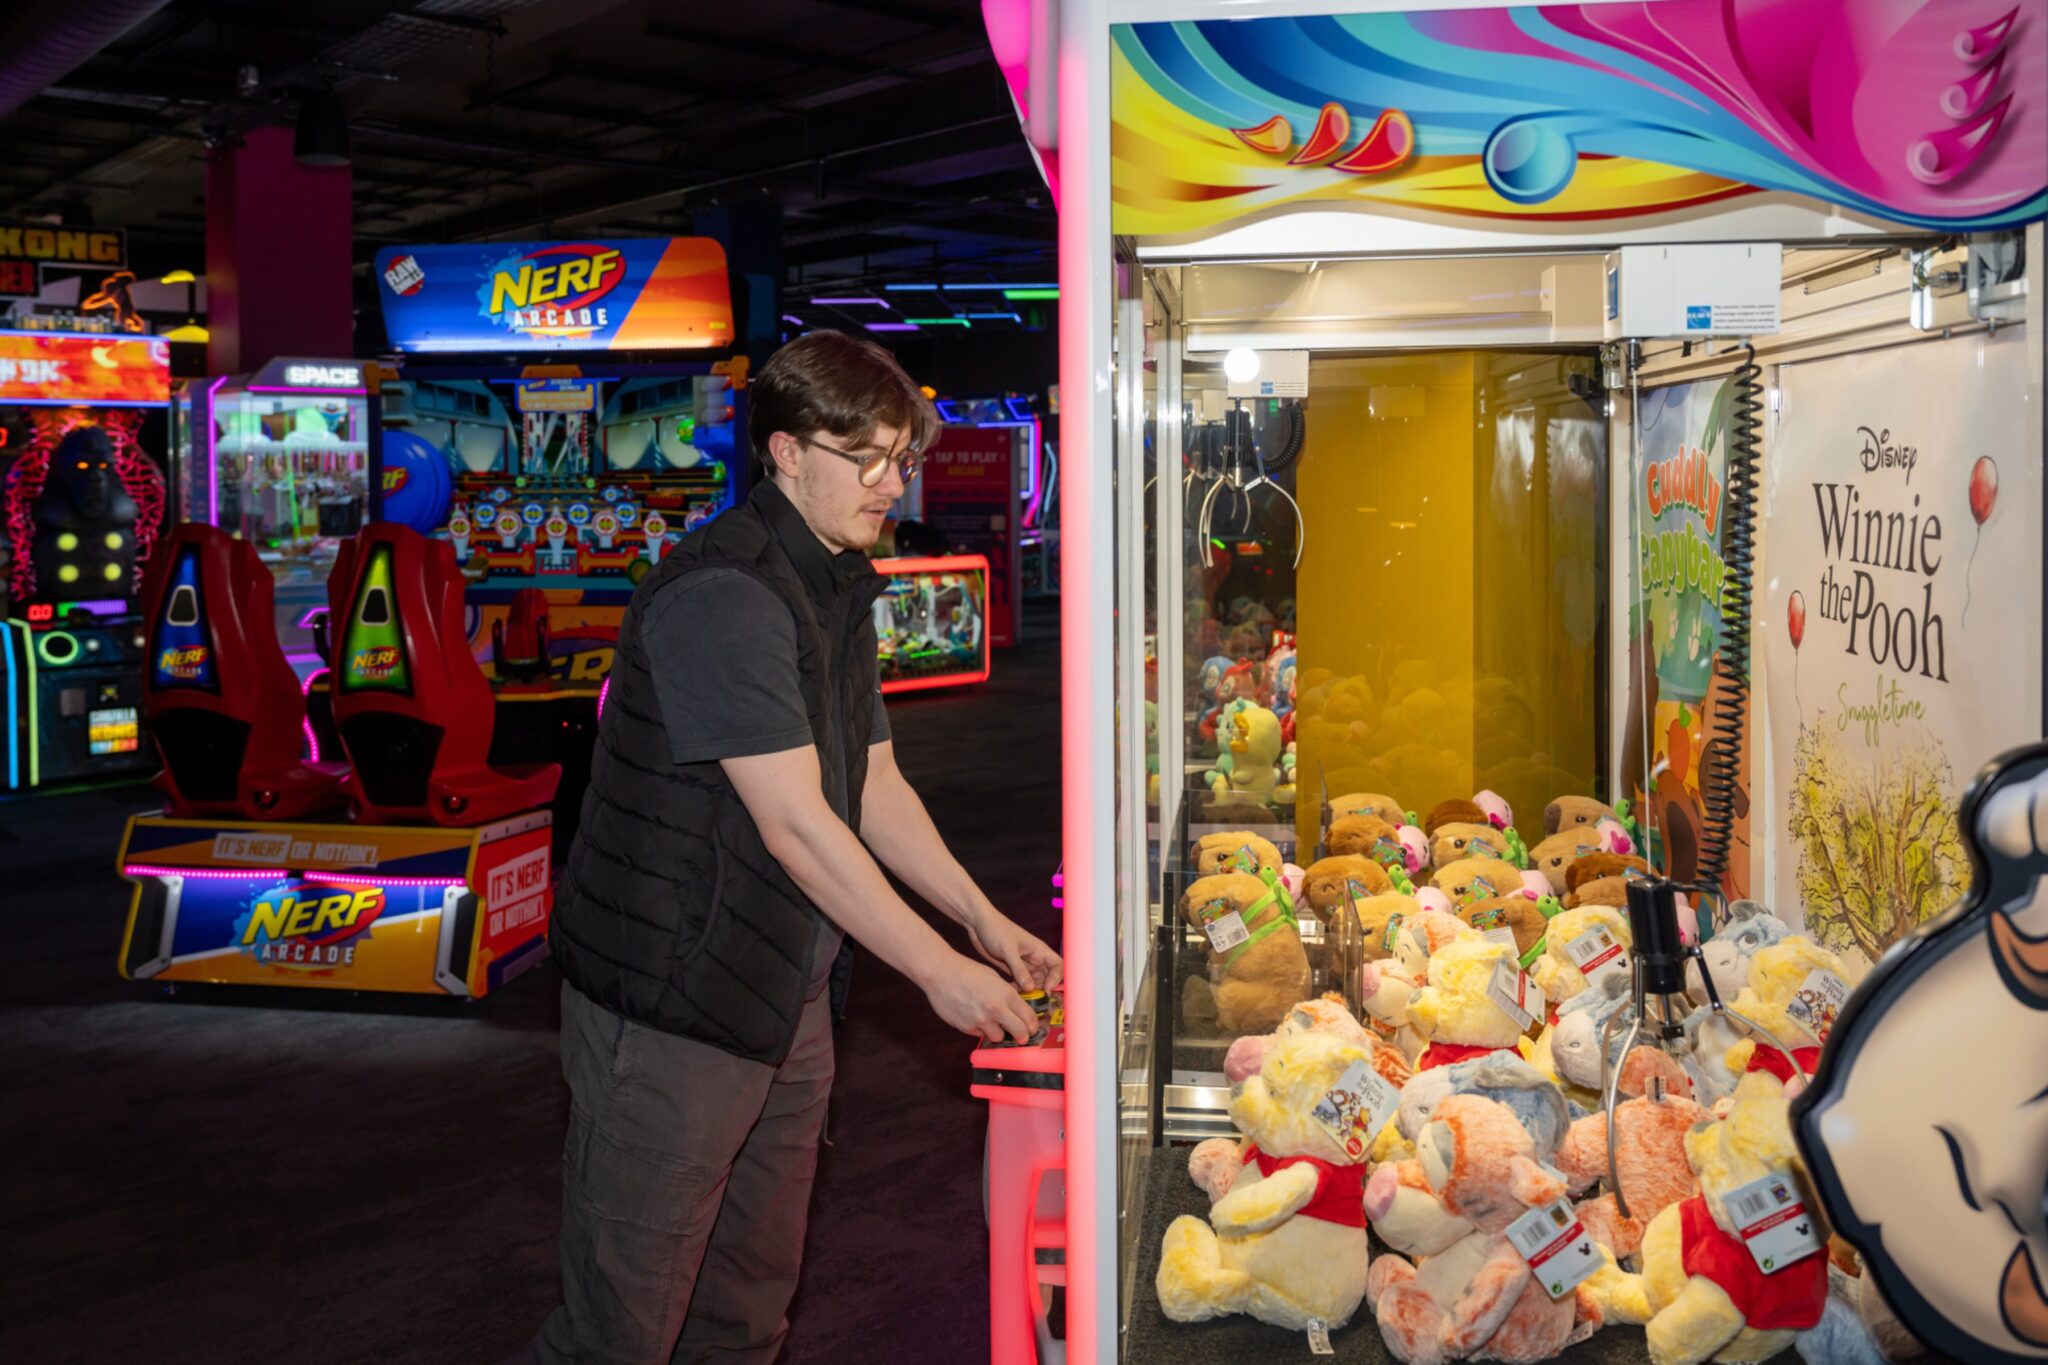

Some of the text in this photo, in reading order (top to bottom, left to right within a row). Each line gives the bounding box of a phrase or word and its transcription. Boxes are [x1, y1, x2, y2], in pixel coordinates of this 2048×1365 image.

[0, 228, 119, 262] KONG
[489, 250, 620, 315] NERF
[514, 308, 608, 327] ARCADE
[286, 366, 359, 386] SPACE
[935, 451, 998, 464] TAP TO PLAY
[1647, 444, 1722, 537] Cuddly
[1812, 483, 1942, 577] Winnie
[1819, 565, 1949, 684] the Pooh
[161, 647, 208, 669] NERF
[353, 649, 401, 670] NERF
[1837, 674, 1925, 747] Snuggletime
[218, 837, 246, 856] IT'S
[249, 839, 286, 858] NERF
[291, 841, 312, 860] OR
[492, 858, 545, 904] IT'S NERF
[241, 888, 384, 945] NERF
[261, 943, 355, 966] ARCADE
